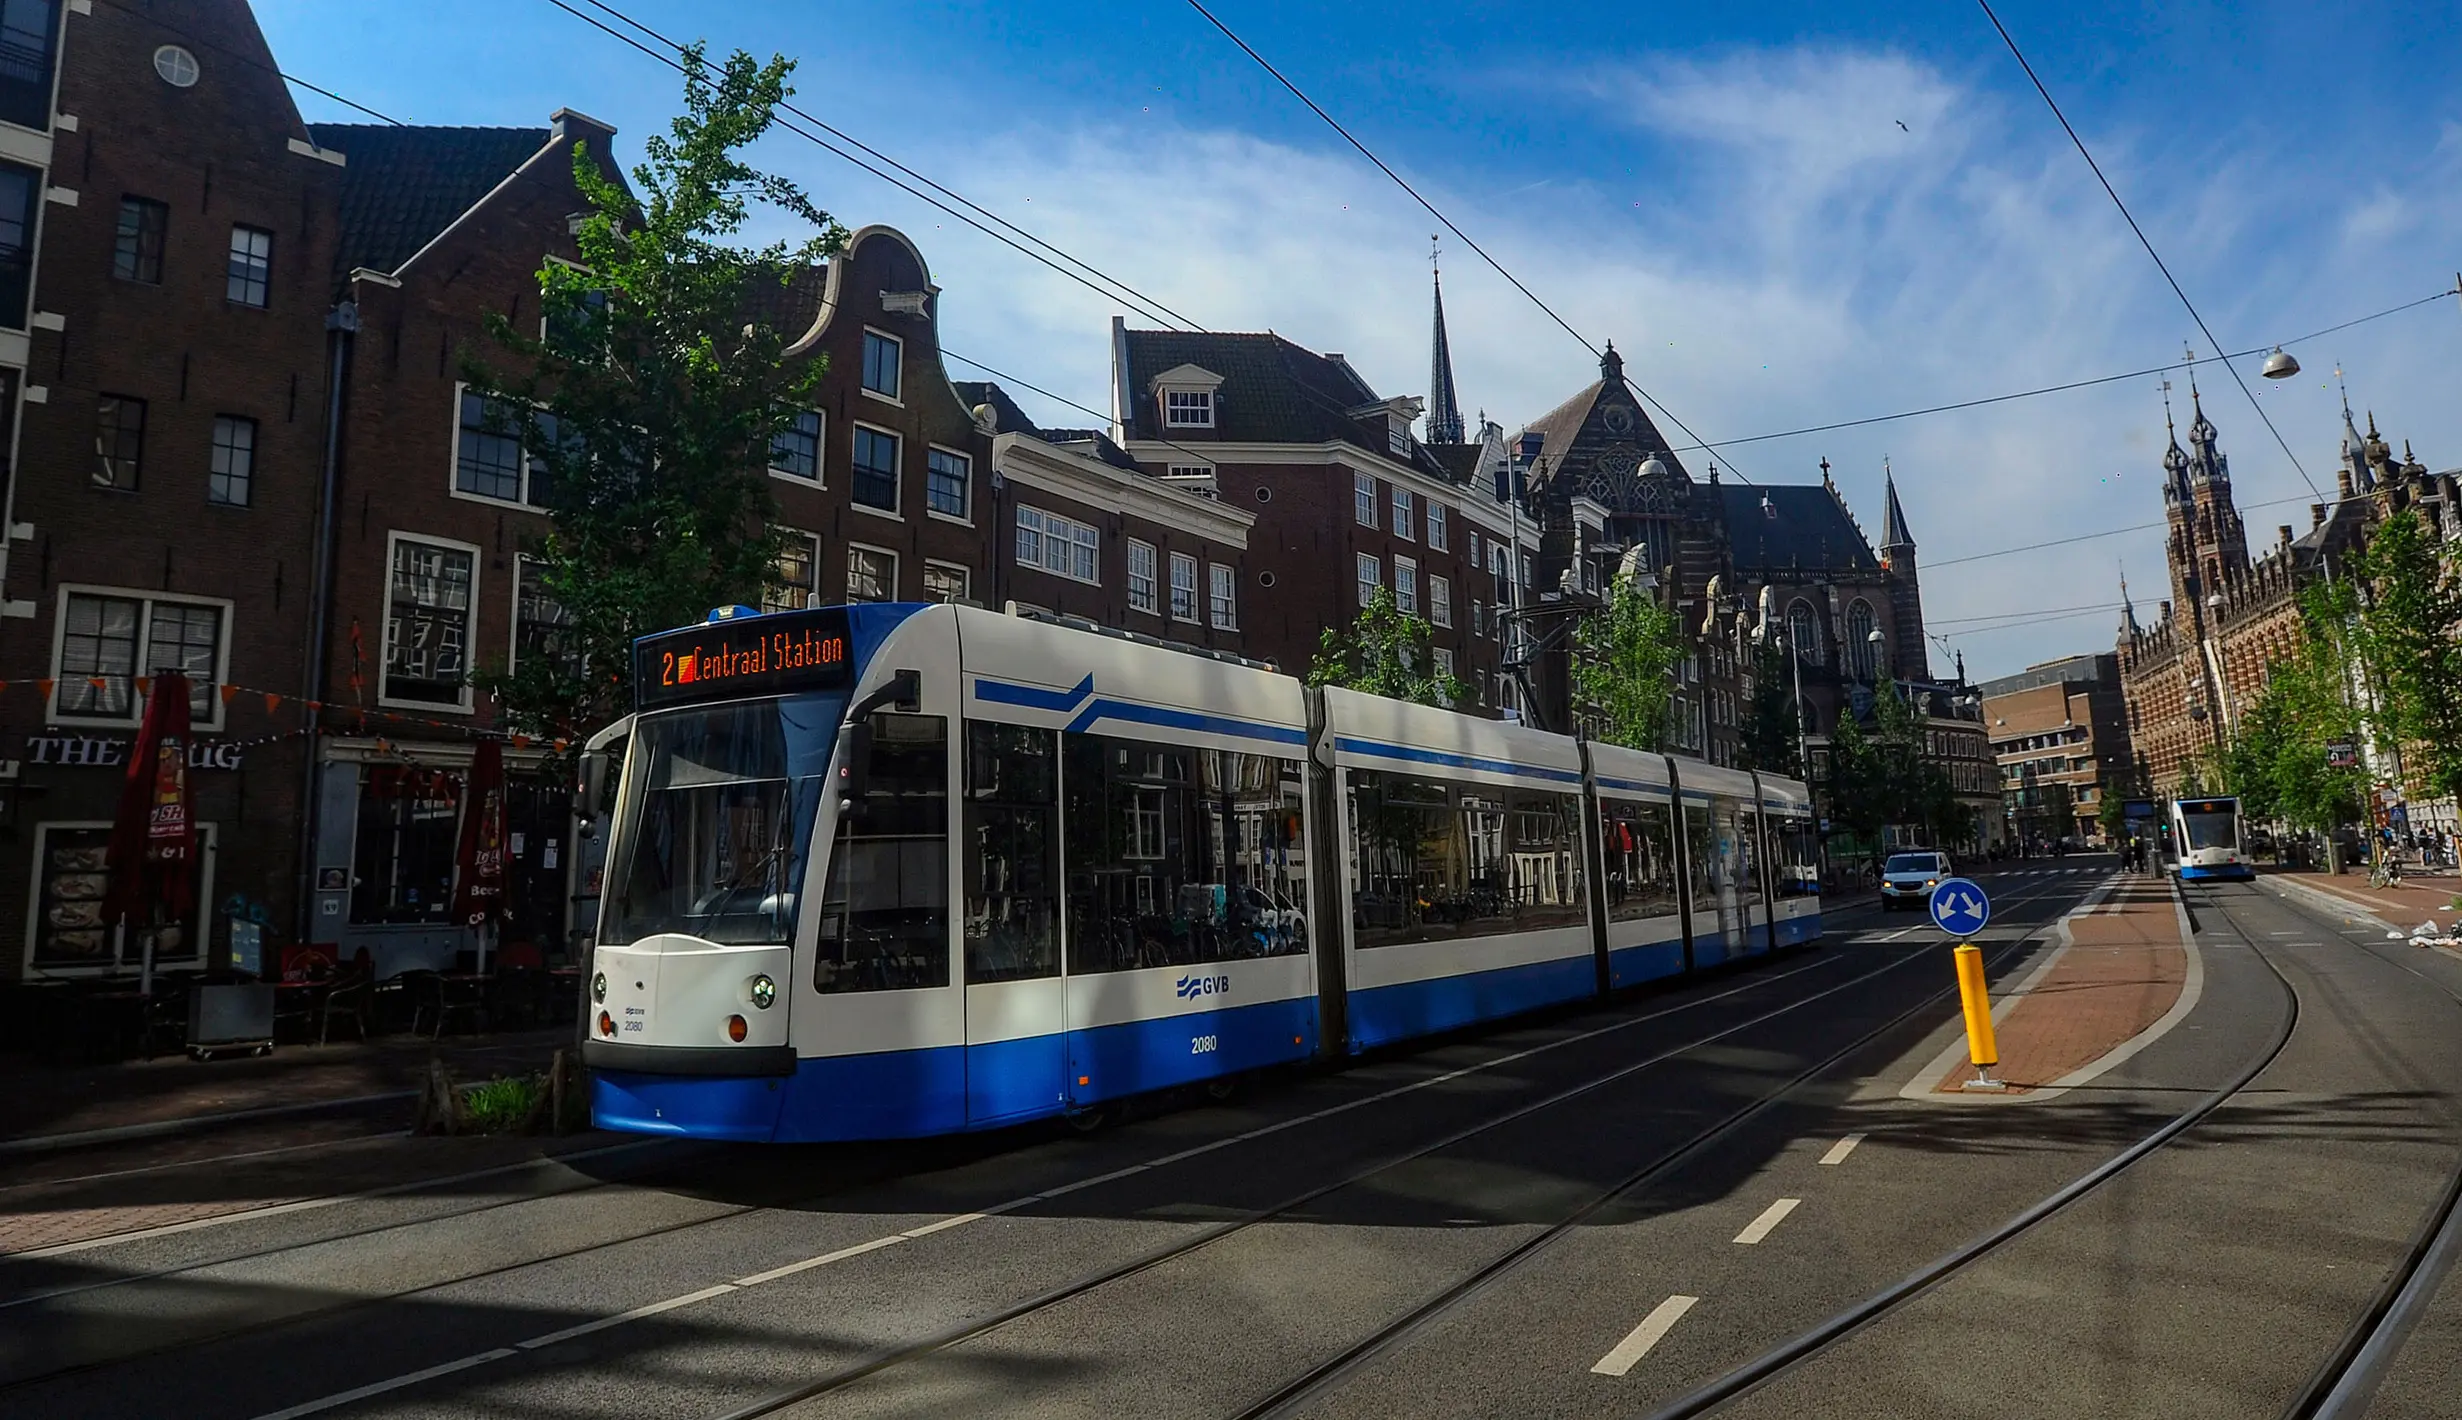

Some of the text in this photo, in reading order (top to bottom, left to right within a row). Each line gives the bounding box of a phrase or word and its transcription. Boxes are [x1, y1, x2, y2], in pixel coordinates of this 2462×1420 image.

[662, 629, 843, 686] 2 Centraal Station
[27, 736, 123, 766] THE
[1203, 976, 1229, 994] GVB
[624, 1020, 643, 1032] 2080
[1191, 1035, 1217, 1054] 2080
